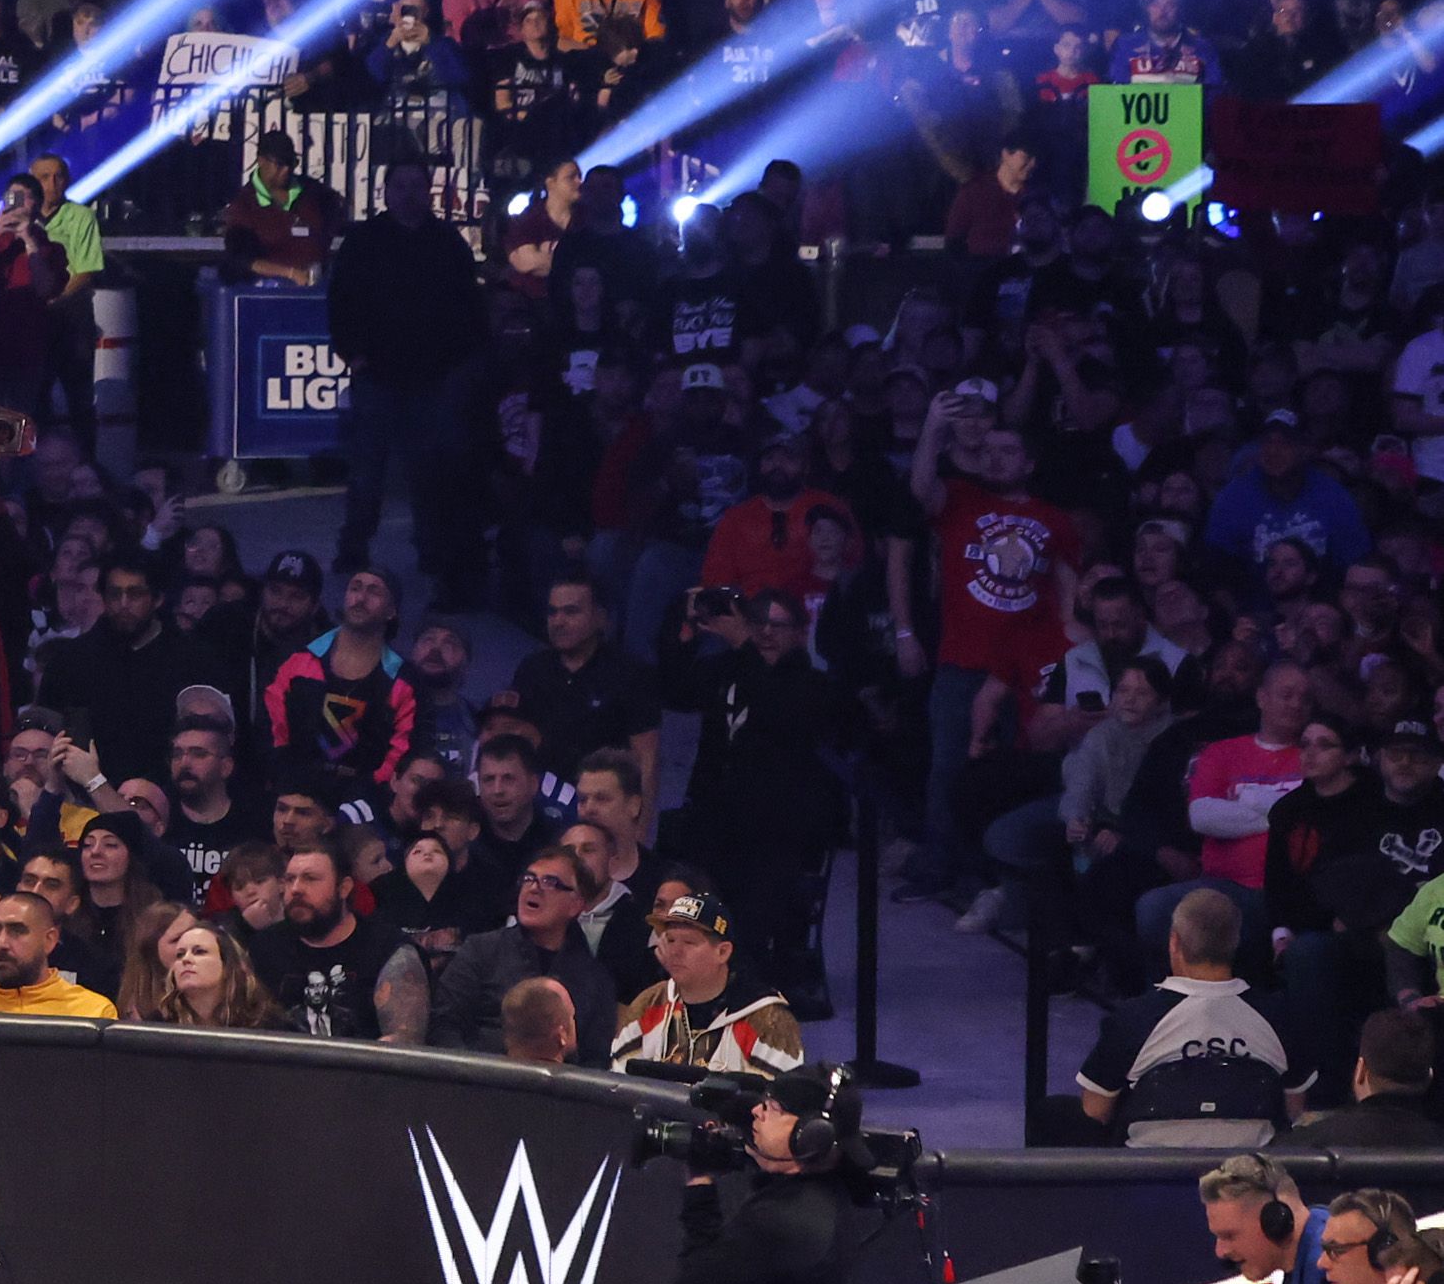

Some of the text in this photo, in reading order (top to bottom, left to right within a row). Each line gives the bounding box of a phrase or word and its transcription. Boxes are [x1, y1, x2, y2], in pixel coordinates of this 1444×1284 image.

[1121, 94, 1170, 127] YOU
[284, 344, 352, 378] BU
[266, 377, 352, 410] LIG
[1181, 1036, 1251, 1060] CSC
